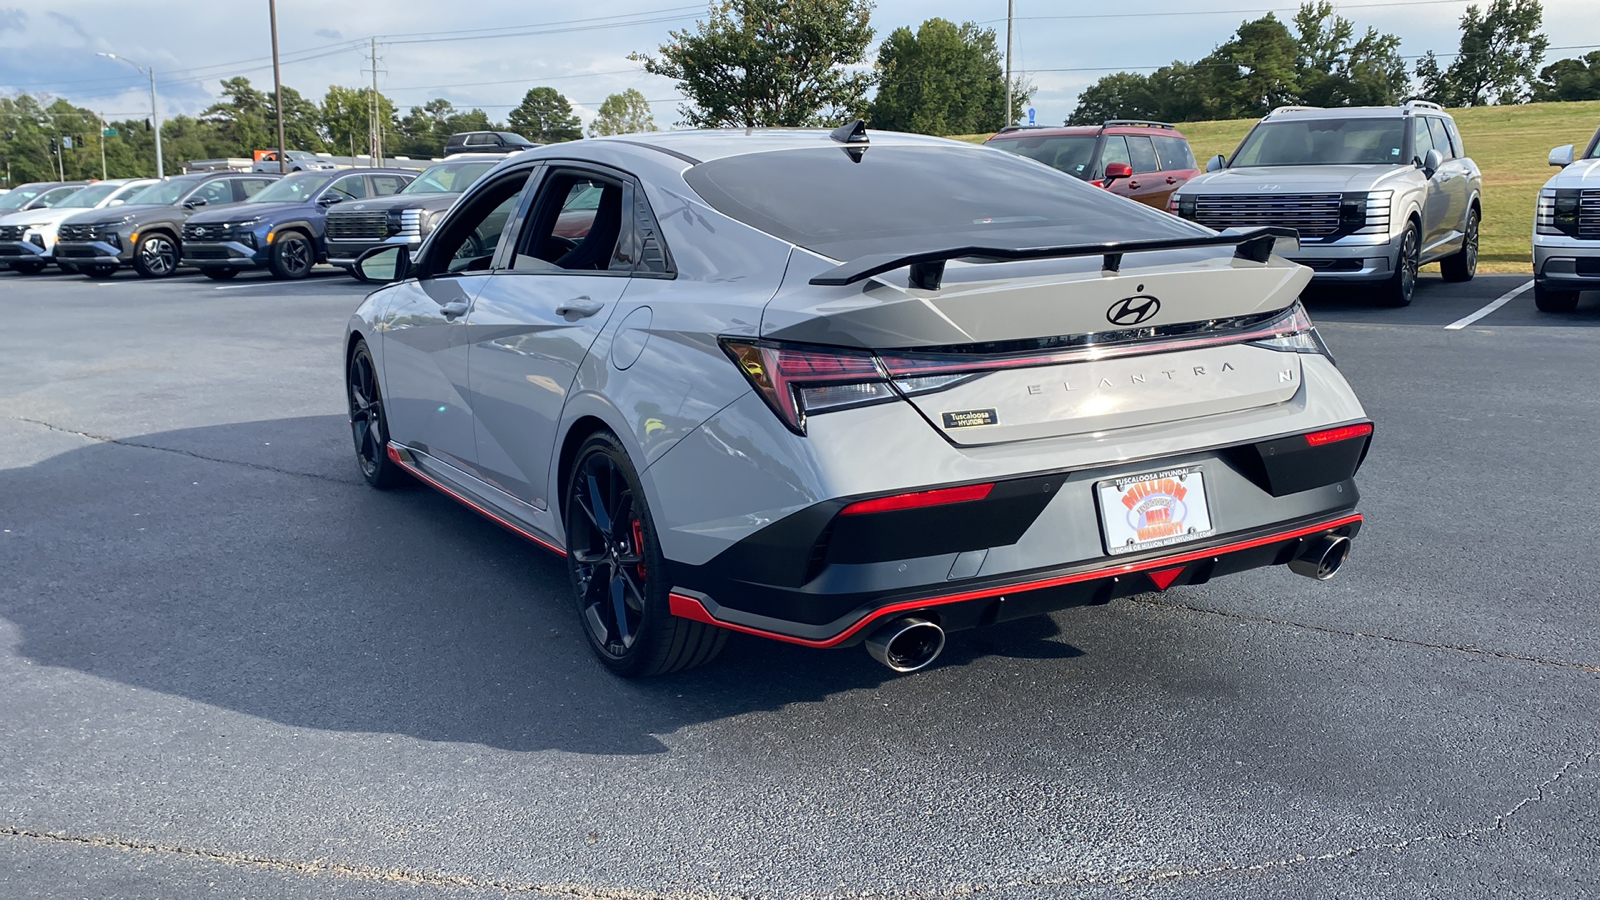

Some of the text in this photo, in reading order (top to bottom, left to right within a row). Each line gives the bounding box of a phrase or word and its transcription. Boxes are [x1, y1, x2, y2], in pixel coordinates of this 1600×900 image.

[1028, 362, 1293, 395] ELANTRA N
[951, 411, 989, 420] Tuscaloosa
[1115, 468, 1189, 486] TUSCALOOSA HYUNDAI
[1121, 478, 1188, 511] MILLION
[1145, 507, 1171, 526] MILE
[1136, 521, 1184, 542] WARRANTY
[1115, 545, 1133, 554] HOME
[1141, 540, 1163, 550] MILLION
